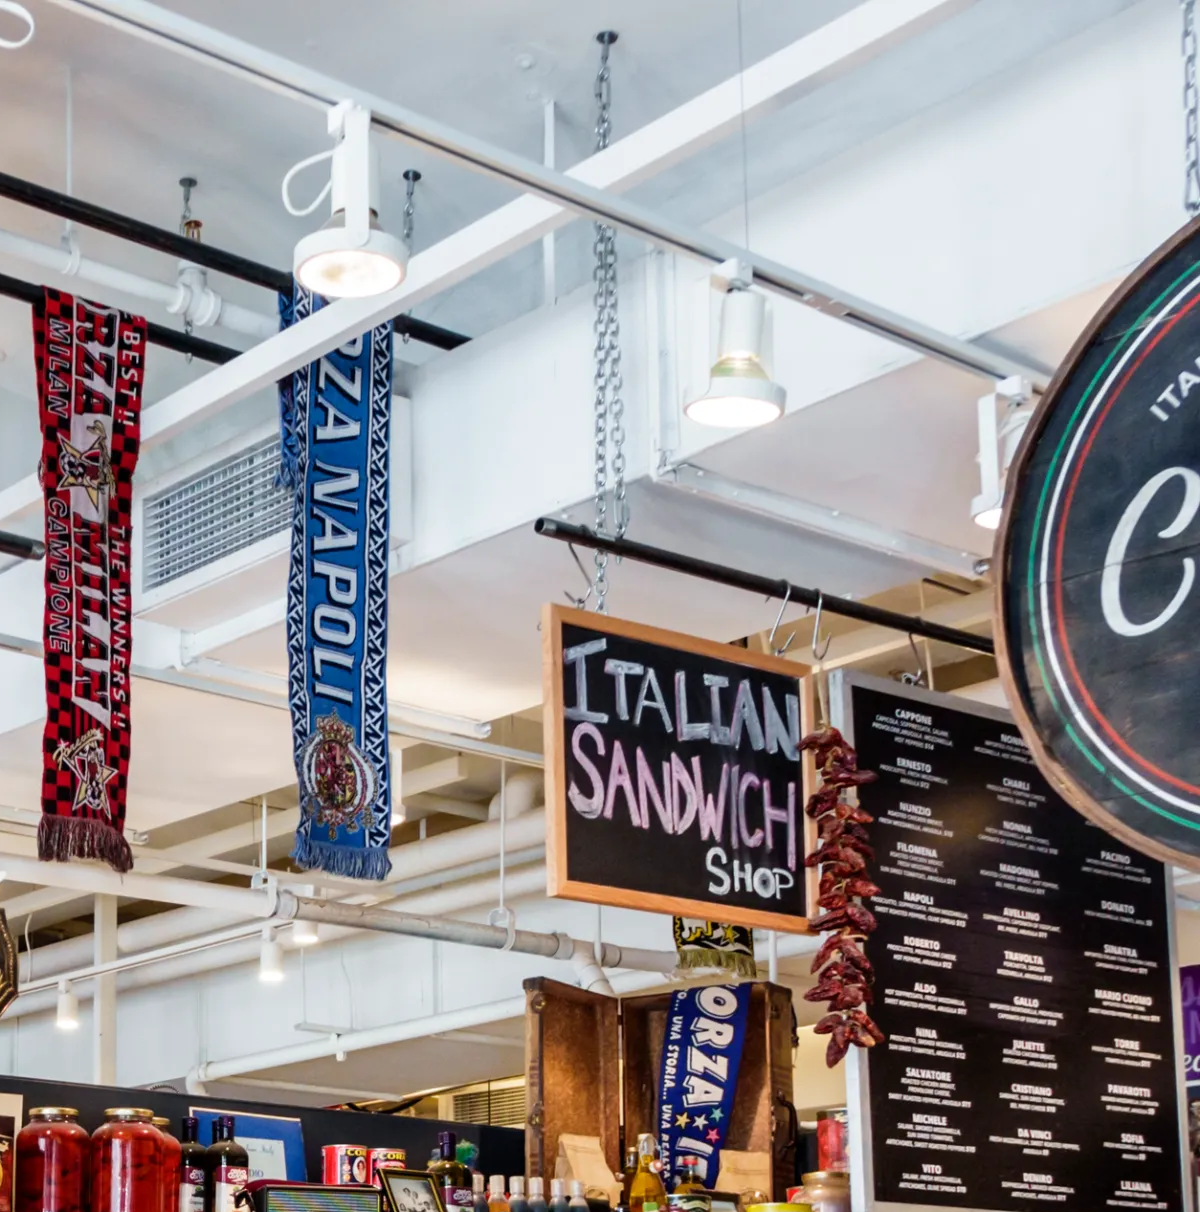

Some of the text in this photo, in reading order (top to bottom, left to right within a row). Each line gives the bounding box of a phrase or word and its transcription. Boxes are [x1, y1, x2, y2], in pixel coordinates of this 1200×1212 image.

[76, 302, 118, 417] RZA
[120, 330, 141, 401] BEST
[48, 318, 71, 419] MILAN
[110, 526, 128, 573] THE
[47, 497, 71, 653] CAMPIONE
[312, 458, 360, 706] NAPOLI
[72, 510, 113, 706] MILAN
[111, 587, 128, 702] WINNERS
[563, 637, 800, 761] ITALIAN
[895, 708, 932, 726] CAPPONE
[896, 757, 932, 773] ERNESTO
[567, 722, 796, 872] SANDWICH
[899, 802, 931, 817] NUNZIO
[1003, 820, 1032, 835] NONNA
[896, 841, 938, 858] FILOMENA
[705, 846, 794, 899] SHOP
[999, 863, 1040, 879] MADONNA
[903, 891, 934, 905] NAPOLI
[1003, 907, 1041, 922] AVELLINO
[903, 935, 941, 951] ROBERTO
[1003, 950, 1044, 966] TRAVOLTA
[1103, 944, 1138, 958] SINATRA
[914, 982, 937, 995] ALDO
[1094, 989, 1121, 1003] MARIO
[1013, 995, 1040, 1009] GALLO
[915, 1026, 938, 1040] NINA
[682, 985, 738, 1108] ORZA
[1012, 1039, 1045, 1052] JULIETTE
[1114, 1038, 1140, 1051] TORRE
[905, 1067, 952, 1082] SALVATORE
[1011, 1083, 1053, 1097] CRISTIANO
[1107, 1084, 1151, 1098] PAVAROTTI
[912, 1113, 948, 1127] MICHELE
[1017, 1128, 1052, 1141] DA VINCI
[1121, 1133, 1145, 1145] SOFIA
[922, 1163, 942, 1175] VITO
[1022, 1172, 1053, 1184] DENIRO
[1120, 1180, 1152, 1192] LILIANA
